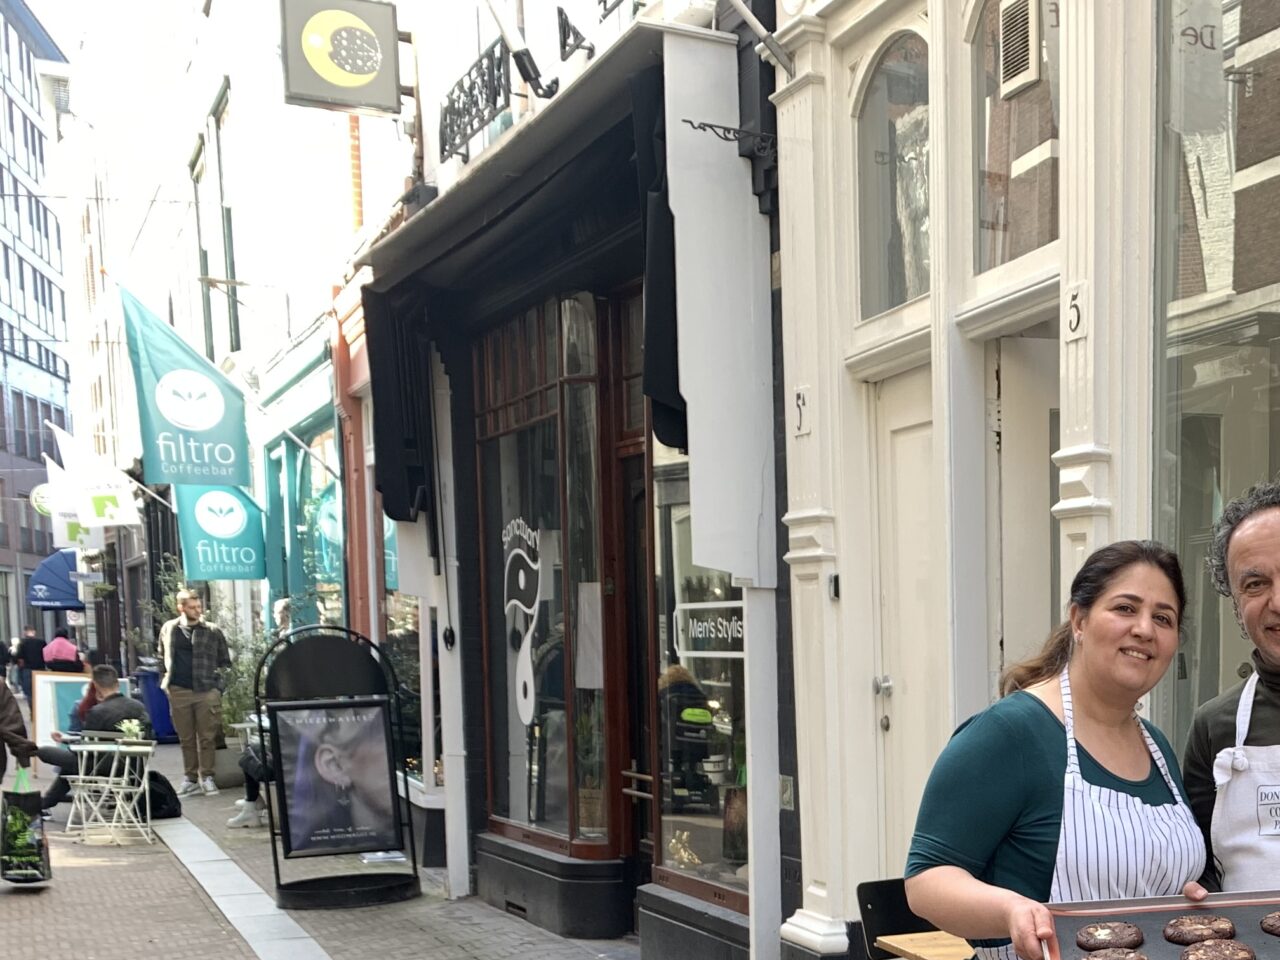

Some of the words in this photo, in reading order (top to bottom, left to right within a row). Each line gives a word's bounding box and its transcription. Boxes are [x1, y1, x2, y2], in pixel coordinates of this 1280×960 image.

[1069, 292, 1081, 333] 5
[156, 431, 236, 464] filtro
[161, 463, 235, 476] Coffeebar
[502, 516, 540, 549] sanctuary
[196, 539, 256, 564] filtro
[200, 562, 256, 573] Coffeebar
[689, 618, 715, 638] Men's
